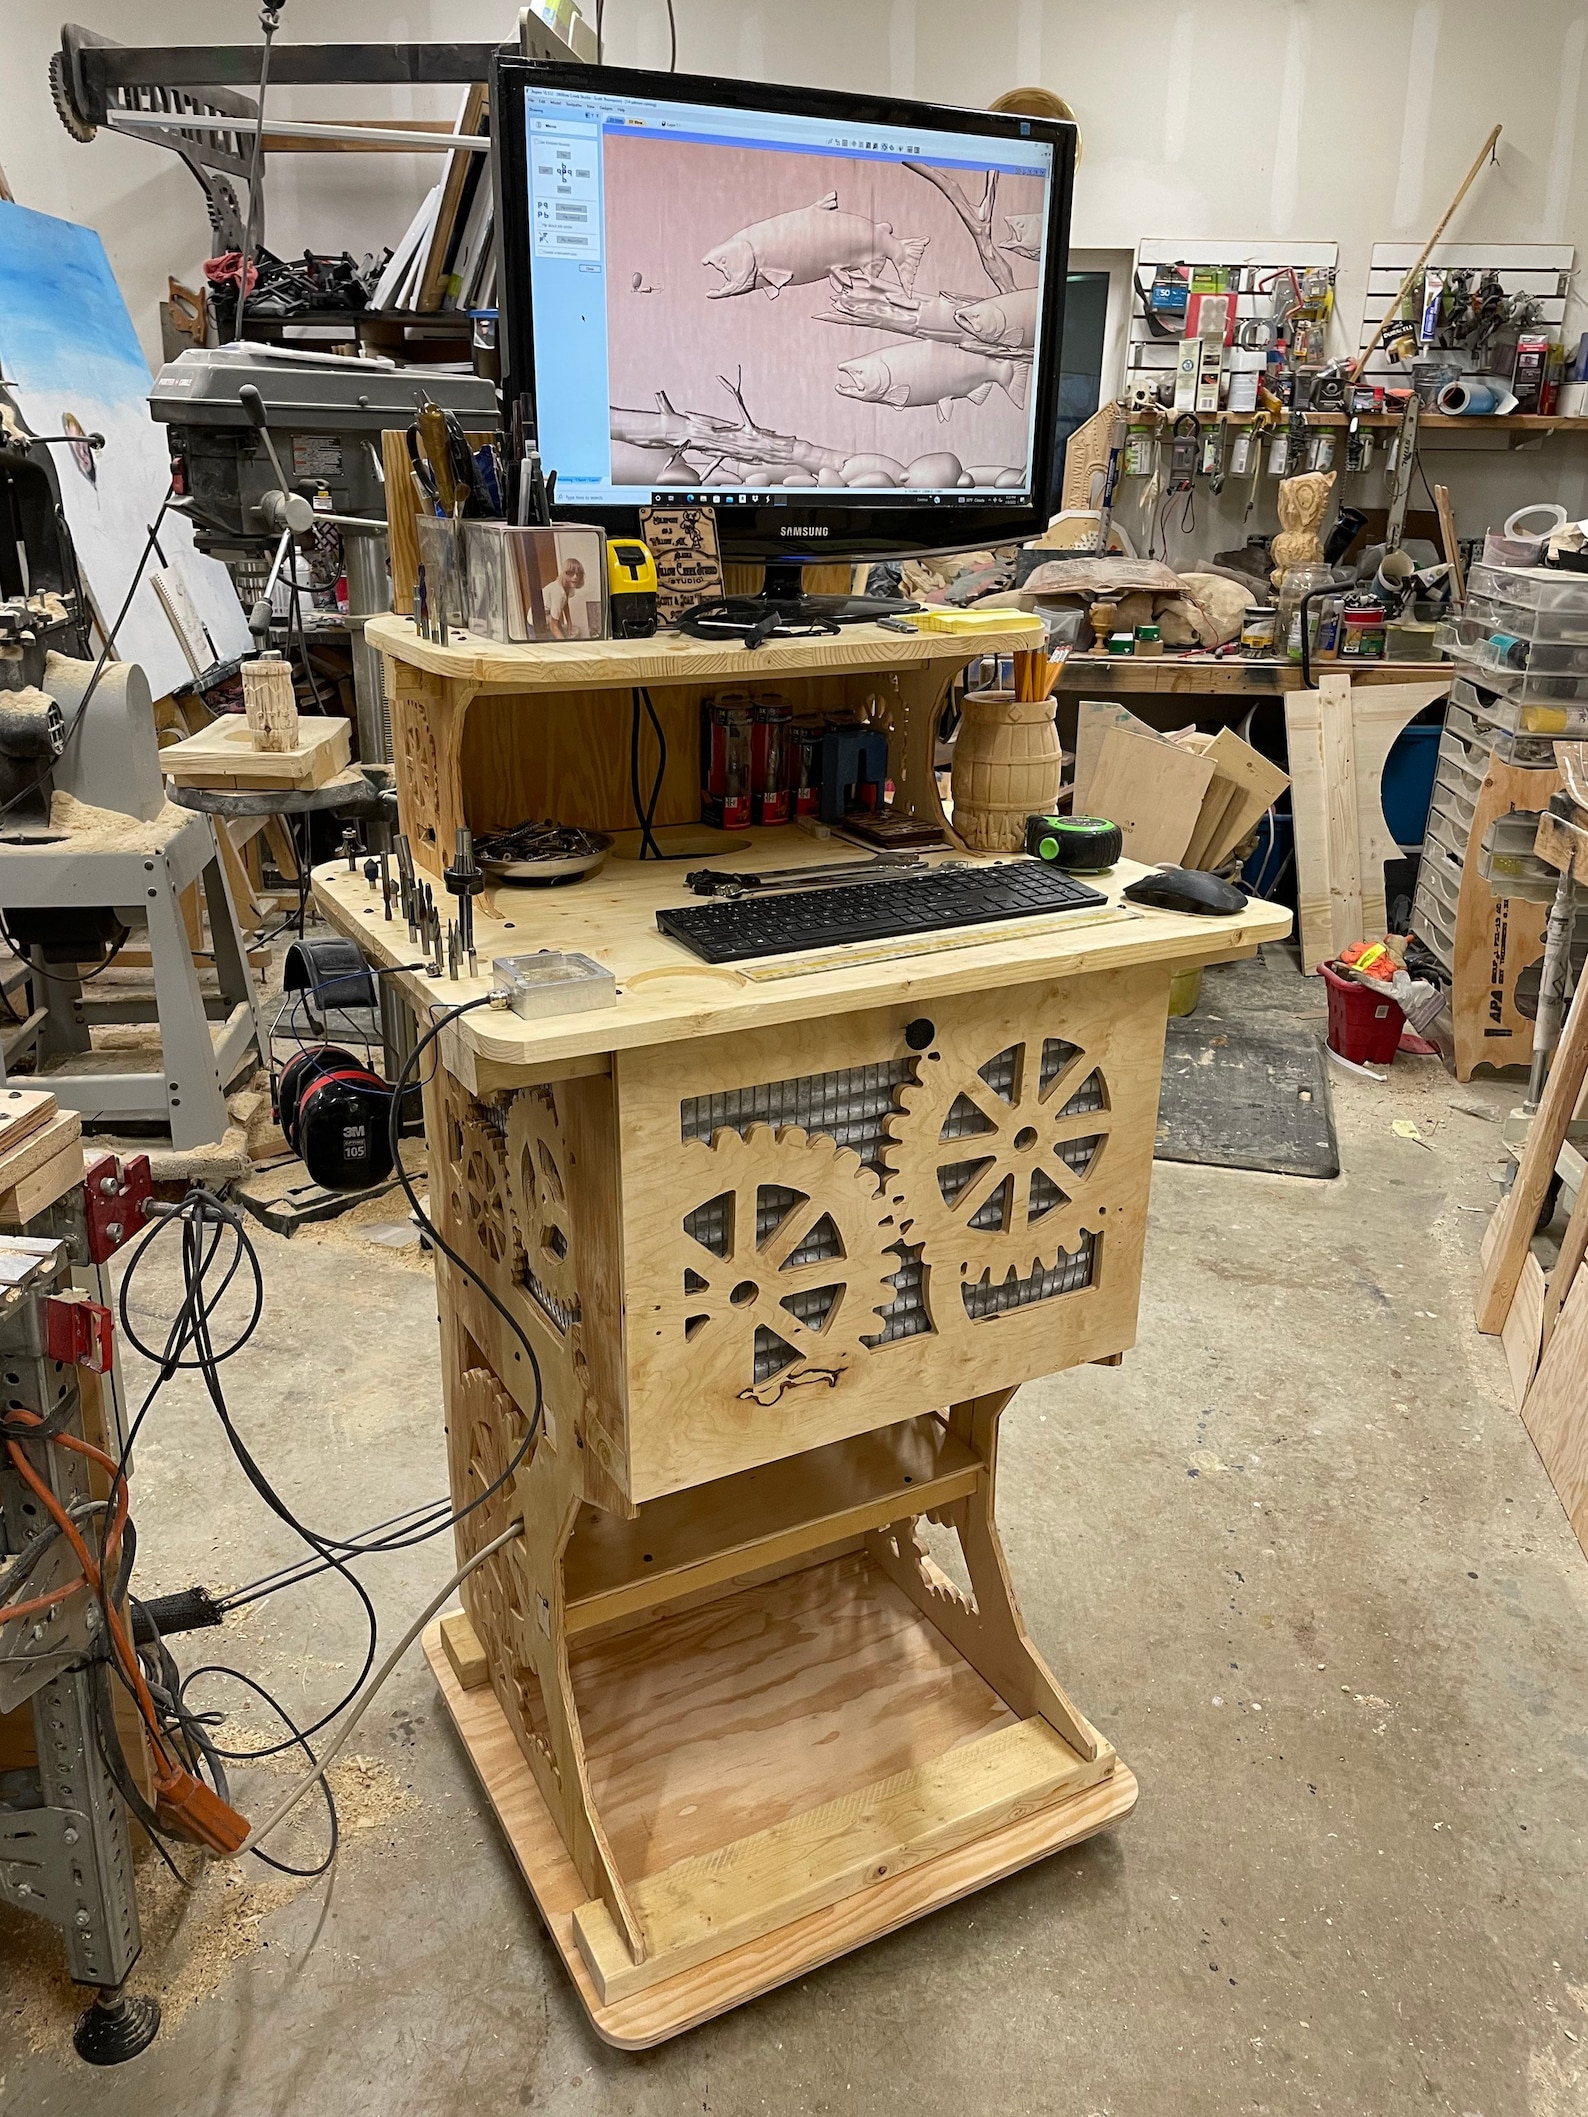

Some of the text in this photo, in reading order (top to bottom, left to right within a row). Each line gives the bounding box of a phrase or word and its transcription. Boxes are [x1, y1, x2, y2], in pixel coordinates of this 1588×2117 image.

[780, 526, 828, 536] SAMSUNG
[1490, 990, 1502, 1024] APA
[343, 1126, 365, 1138] 3M
[345, 1146, 364, 1157] 105
